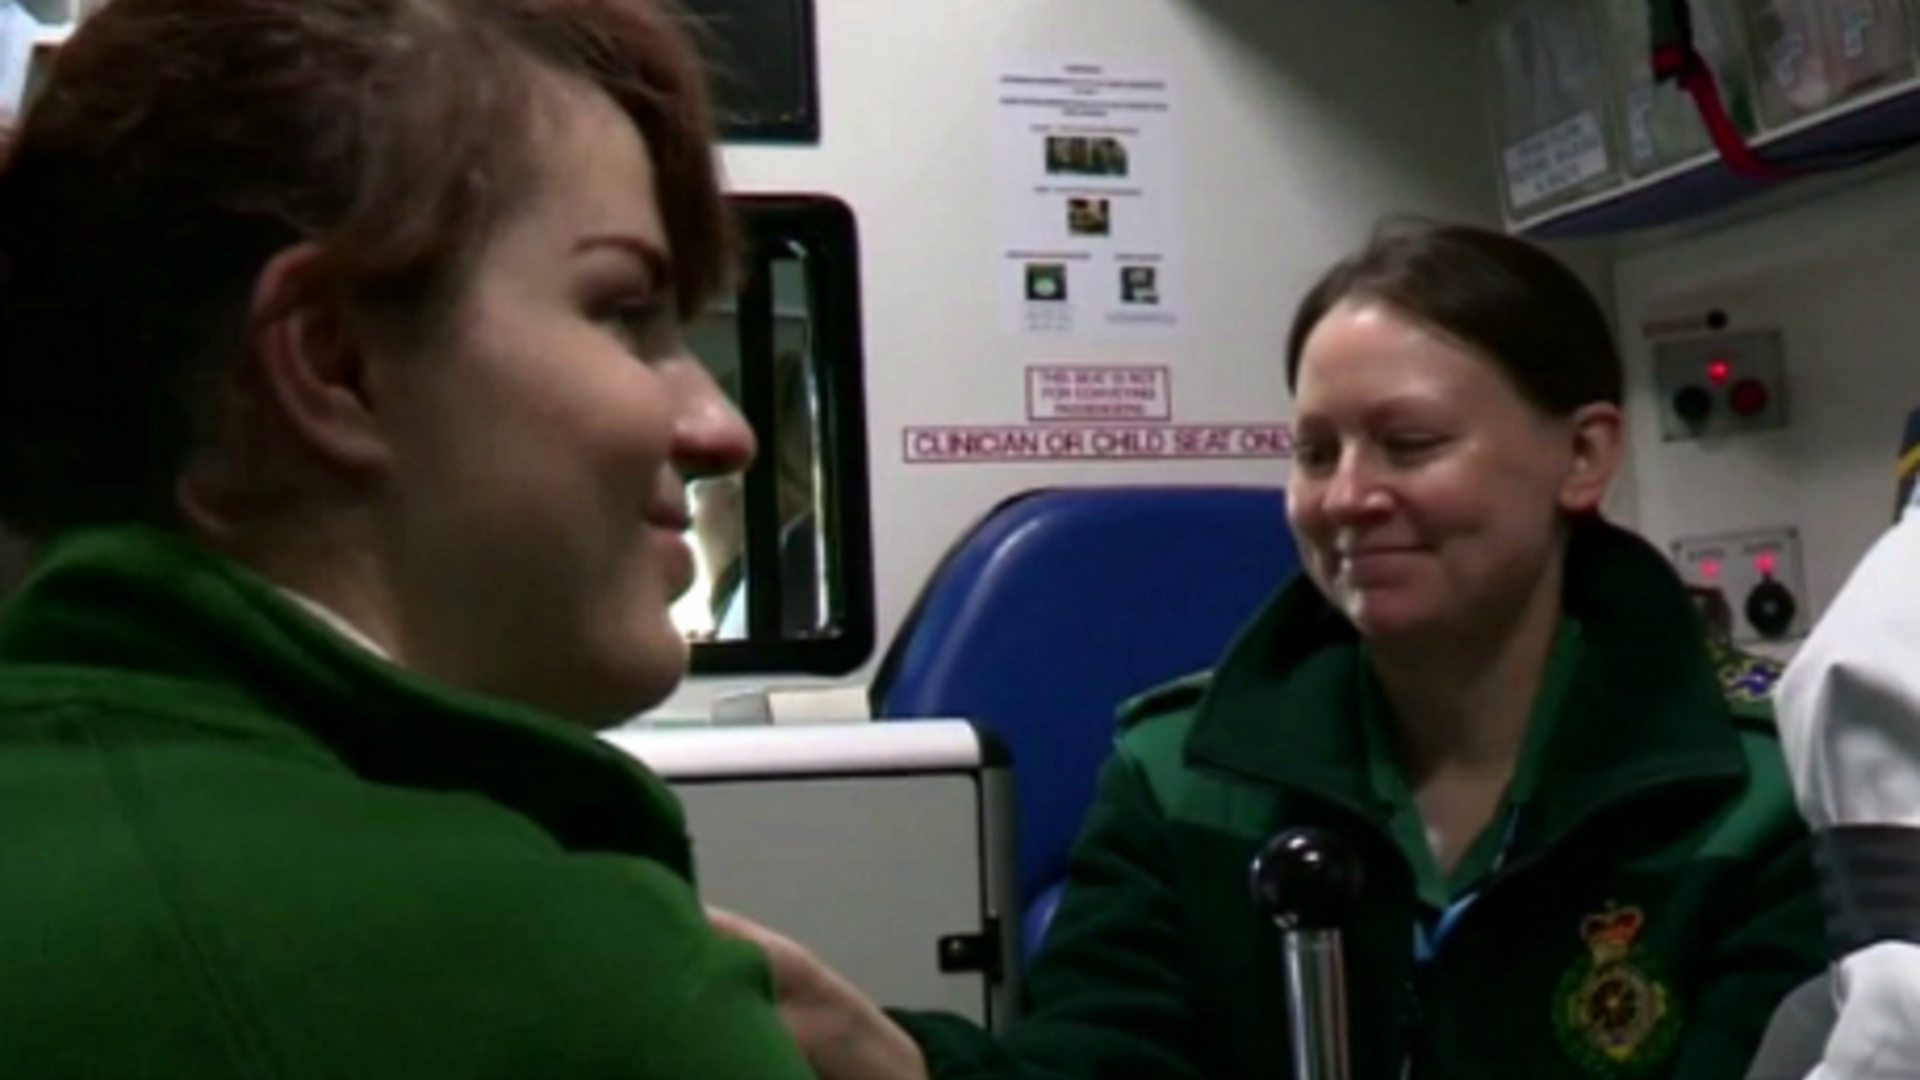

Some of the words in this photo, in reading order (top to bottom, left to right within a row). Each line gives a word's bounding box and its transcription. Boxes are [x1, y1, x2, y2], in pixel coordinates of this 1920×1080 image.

[1129, 370, 1156, 384] NOT
[1042, 387, 1071, 399] FOR
[915, 431, 1037, 456] CLINICIAN
[1045, 431, 1082, 455] OR
[1091, 431, 1163, 455] CHILD
[1174, 430, 1228, 455] SEAT
